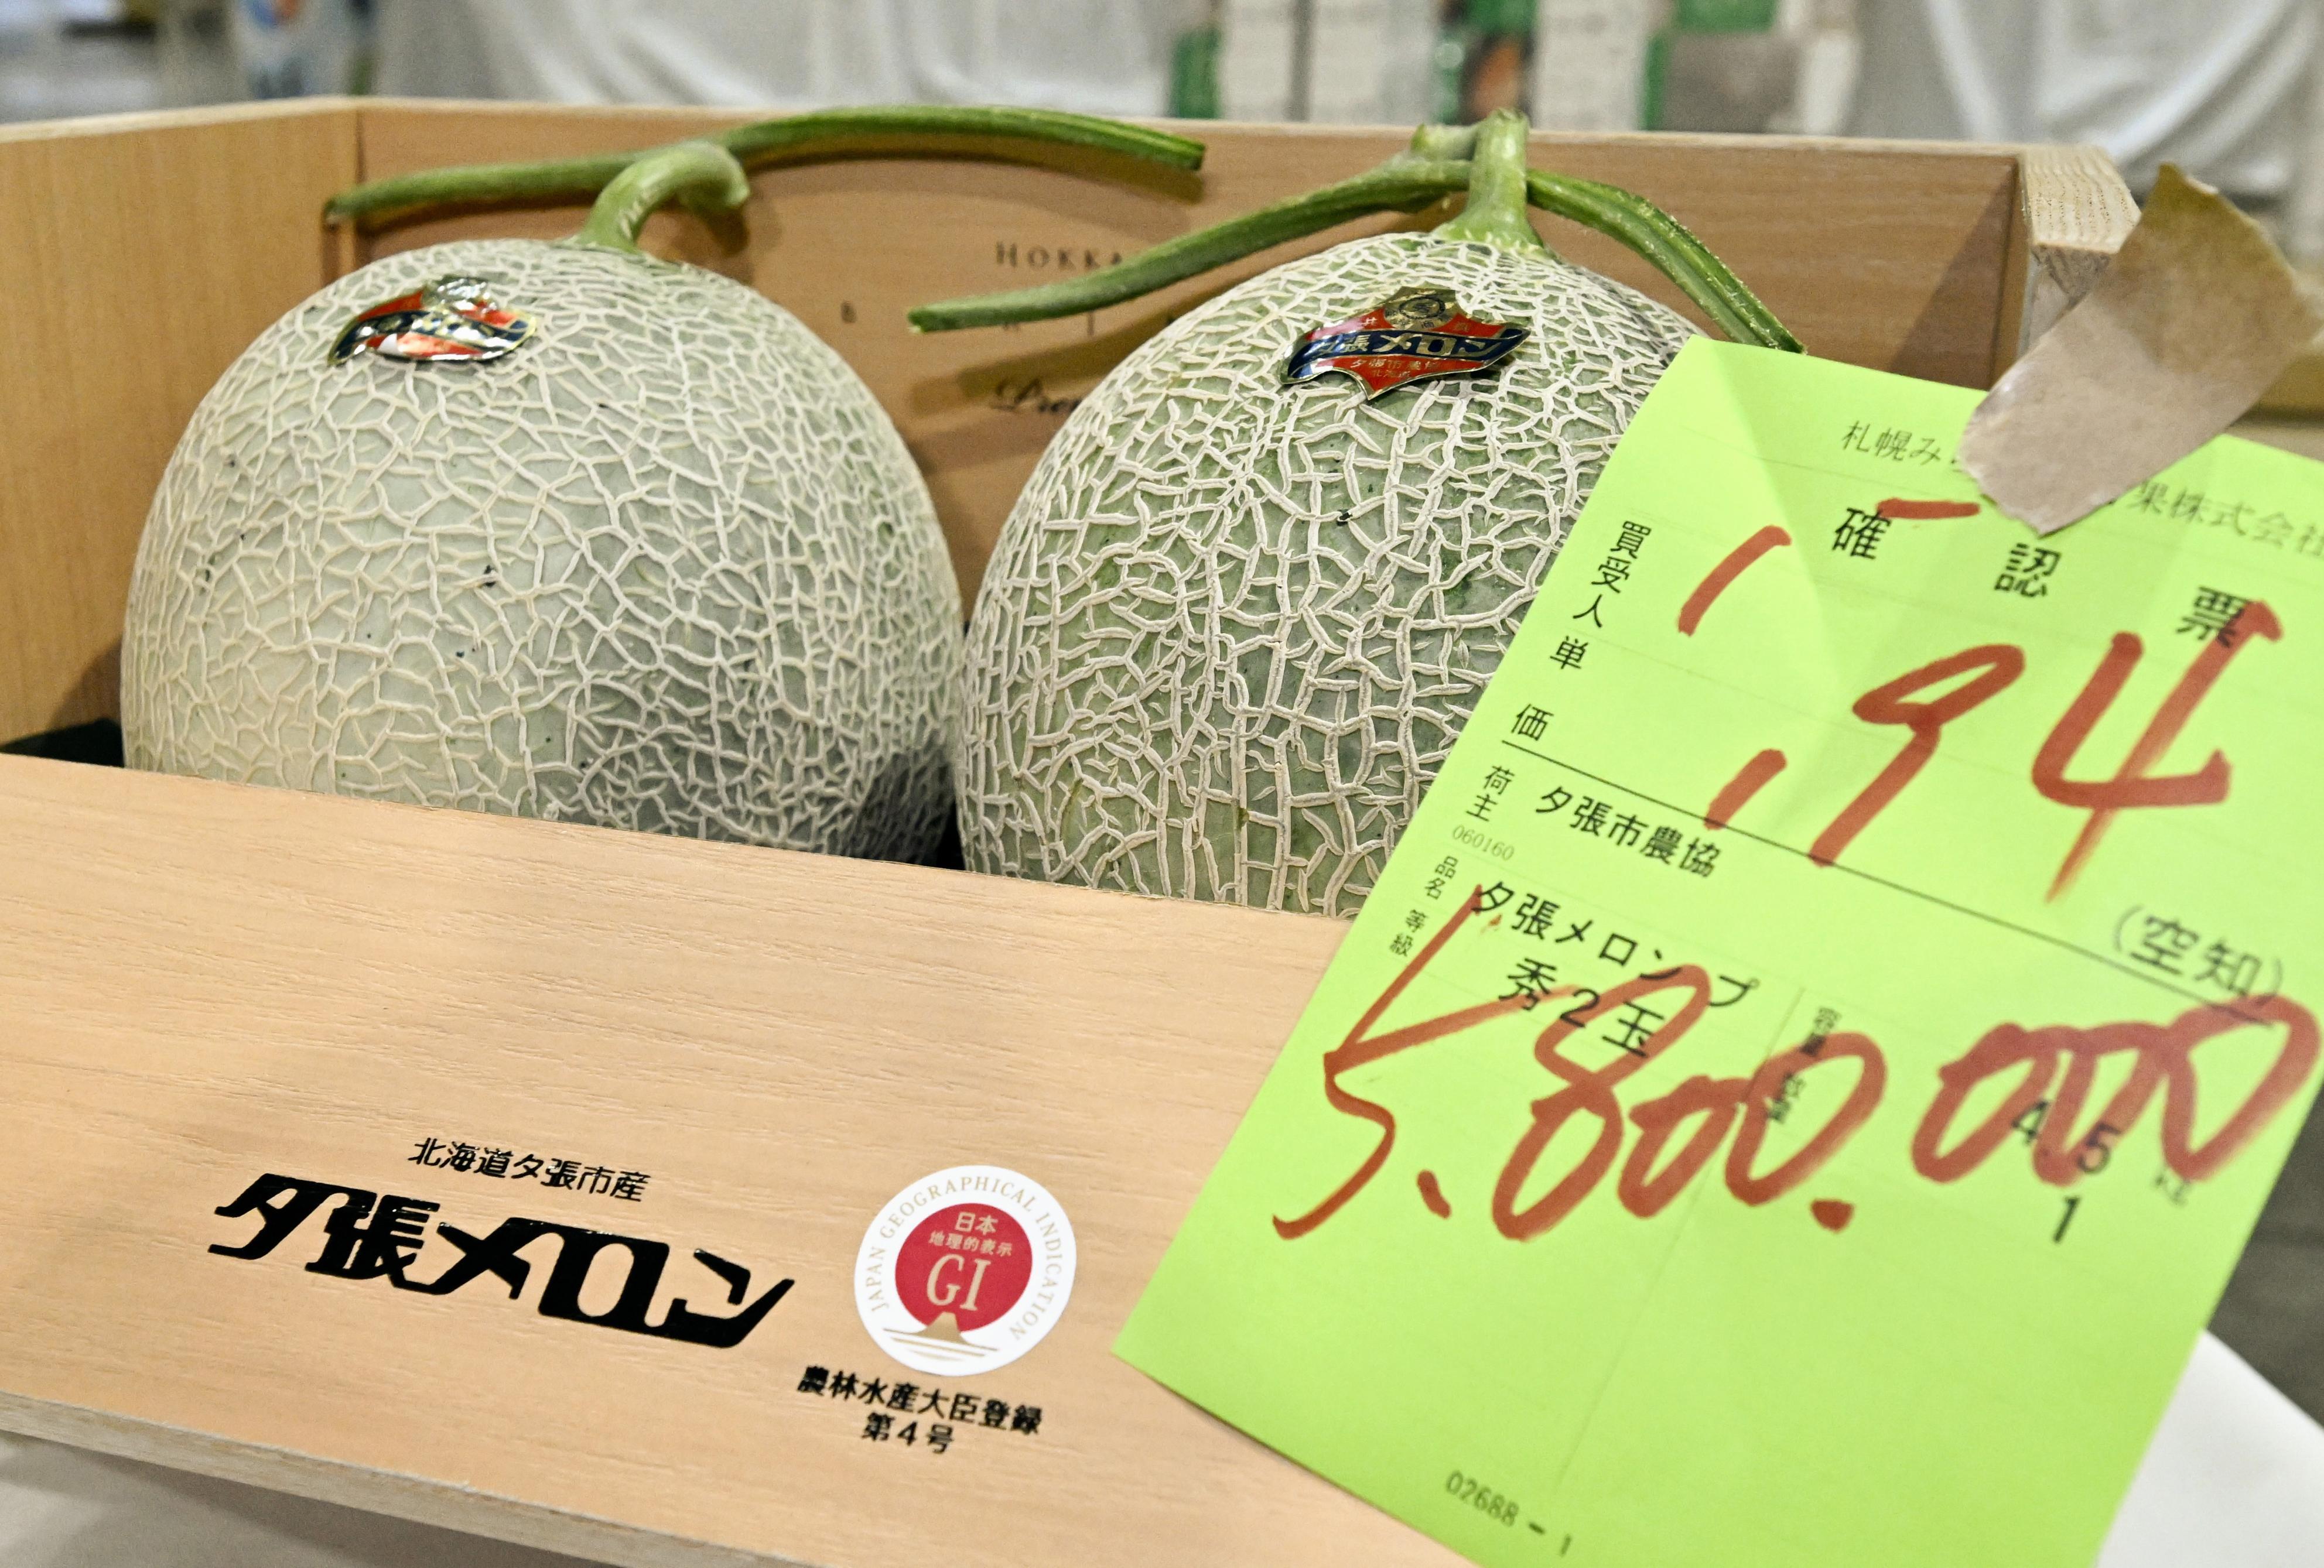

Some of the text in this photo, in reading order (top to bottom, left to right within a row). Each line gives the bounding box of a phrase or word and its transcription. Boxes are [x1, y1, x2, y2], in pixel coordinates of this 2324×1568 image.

[1573, 520, 1653, 628] 買受人
[1467, 765, 1515, 823] 荷主
[1451, 824, 1515, 862] 060160
[1536, 785, 1722, 878] 夕張市農協
[1471, 881, 1761, 1008] 夕張メロンプ
[408, 1137, 651, 1203] 北海道夕張市産
[928, 1230, 1013, 1258] 地理的表示
[954, 1211, 999, 1235] 日本
[2050, 1193, 2082, 1244] 1
[207, 1172, 795, 1349] 夕張メロン
[865, 1175, 1064, 1341] JAPAN GEOGRAPHICAL INDICATION
[926, 1253, 992, 1312] GI
[797, 1365, 1043, 1435] 農林水産大臣登録
[862, 1411, 955, 1454] 第4号
[1445, 1469, 1519, 1527] 02688
